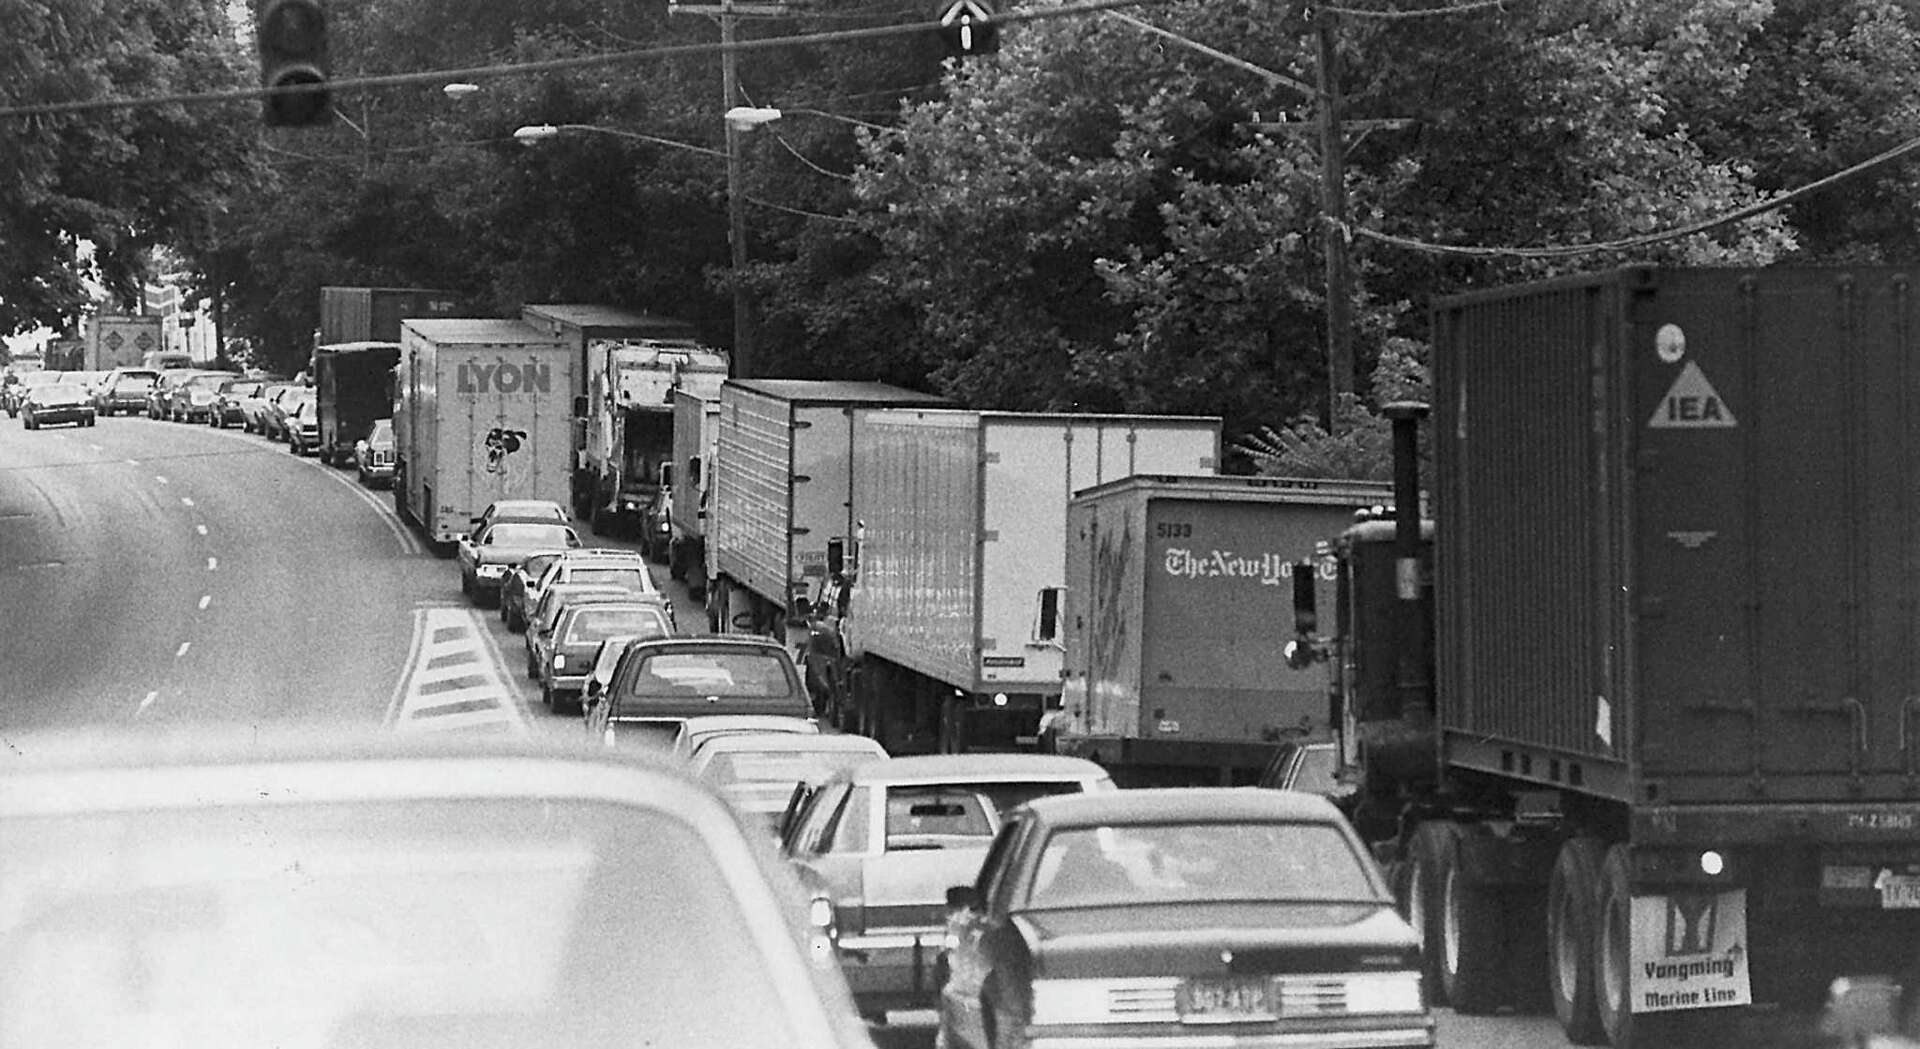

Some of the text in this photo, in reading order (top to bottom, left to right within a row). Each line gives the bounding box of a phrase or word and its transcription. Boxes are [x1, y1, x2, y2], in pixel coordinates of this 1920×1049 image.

[457, 363, 551, 393] LYON
[1669, 396, 1722, 421] IEA
[1157, 522, 1193, 538] 5133
[1165, 547, 1208, 579] The
[1209, 549, 1260, 577] New
[1260, 552, 1320, 586] Yo
[1644, 958, 1735, 982] Yangming
[1644, 987, 1737, 1008] Marine Line
